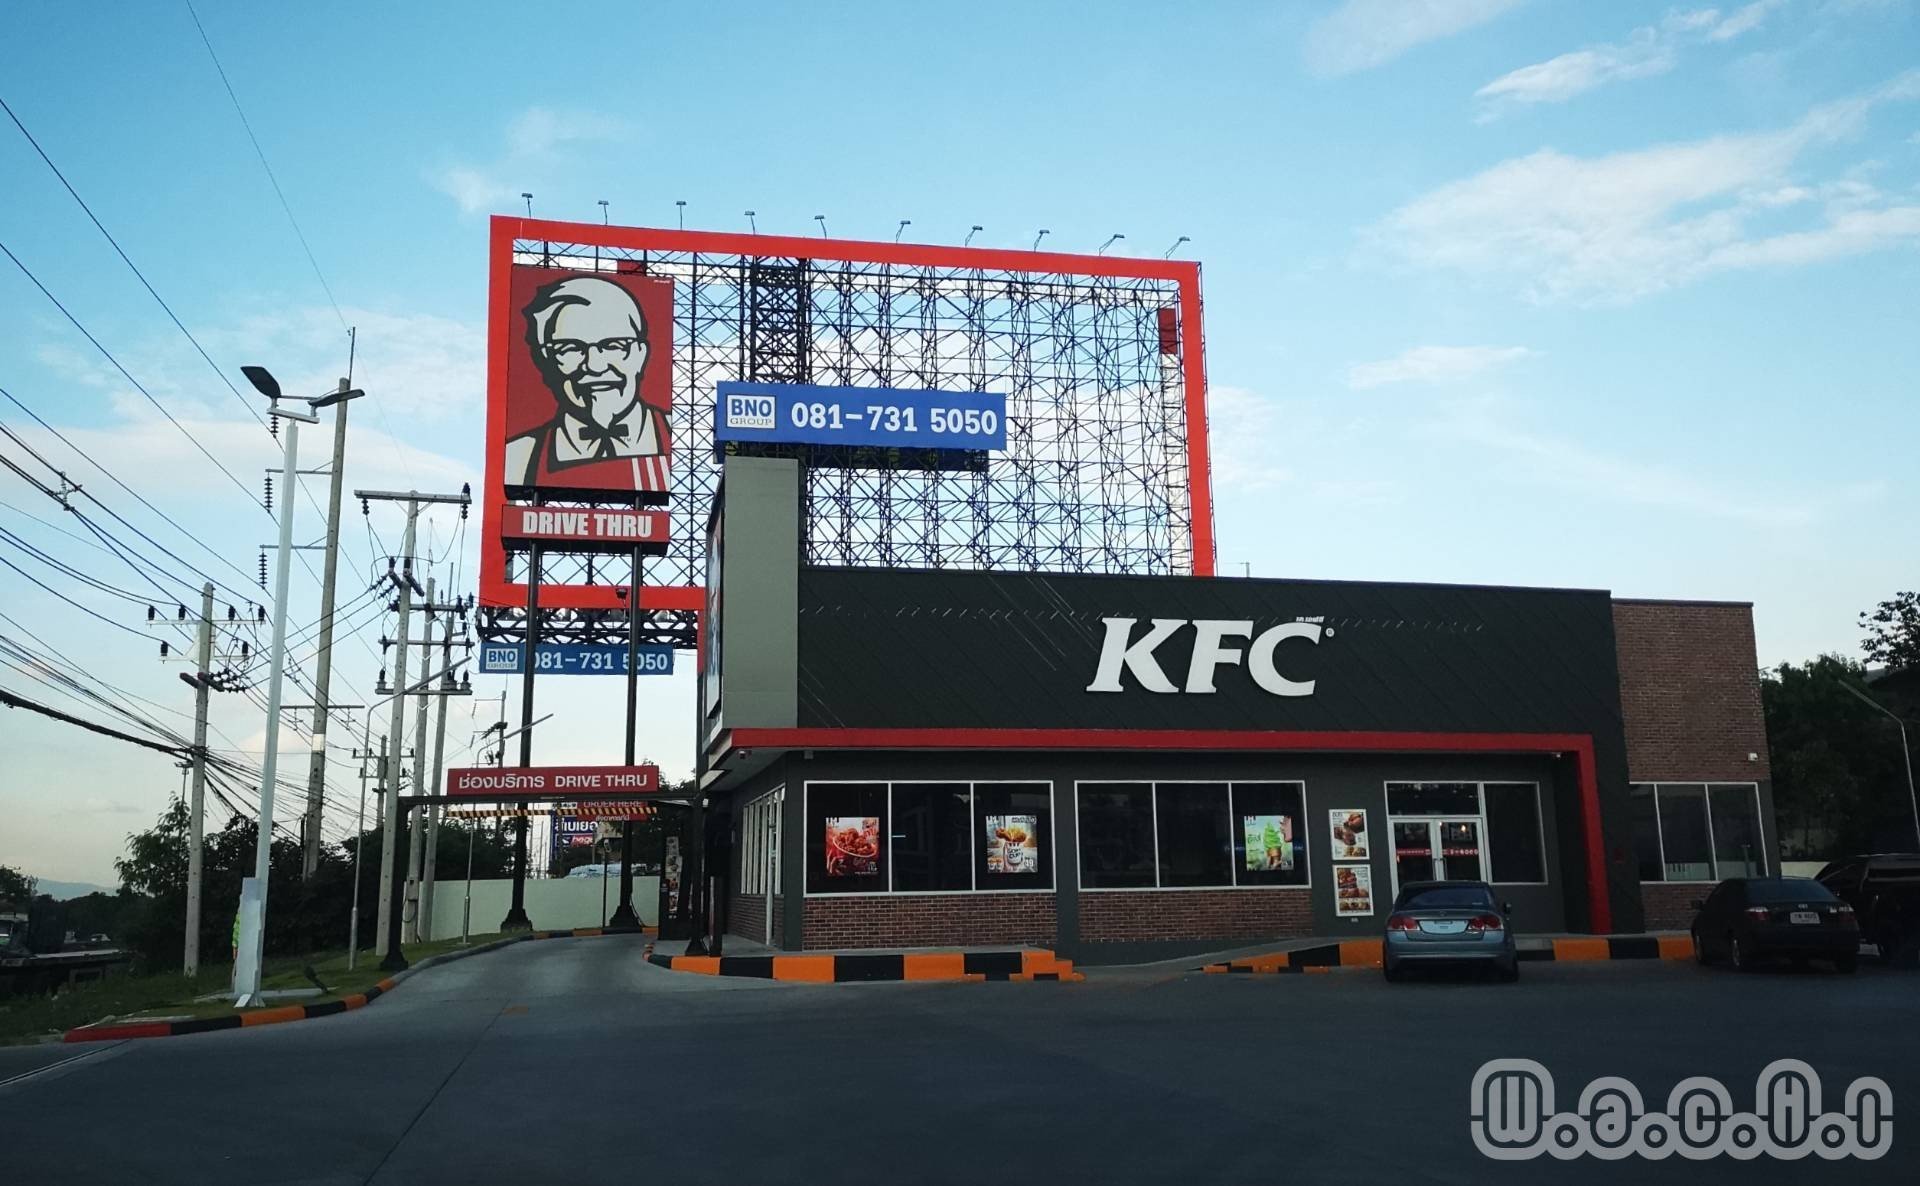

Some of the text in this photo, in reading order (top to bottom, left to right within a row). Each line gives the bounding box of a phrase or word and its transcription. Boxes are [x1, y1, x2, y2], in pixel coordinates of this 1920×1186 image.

[731, 398, 772, 417] BNO
[729, 418, 772, 426] GROUP
[791, 402, 998, 435] 081-731 5050
[523, 511, 652, 537] DRIVE THRU
[488, 650, 516, 663] BNO
[1086, 617, 1322, 697] KFC
[459, 773, 647, 789] ช่องบริการ DRIVE THRU
